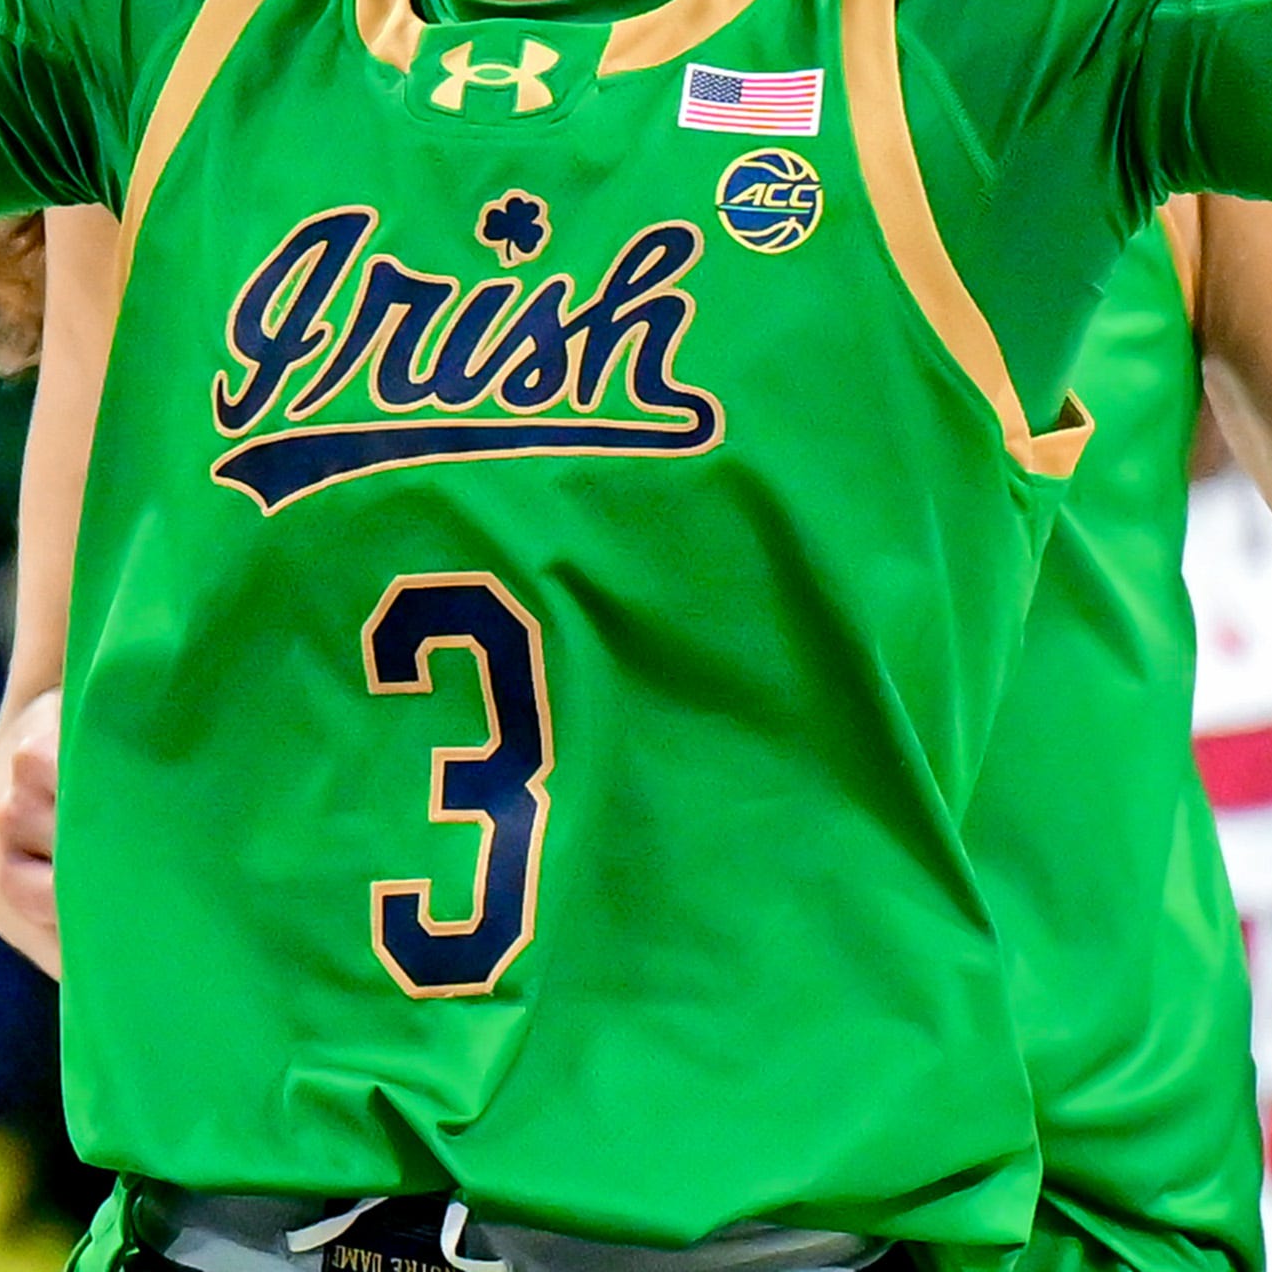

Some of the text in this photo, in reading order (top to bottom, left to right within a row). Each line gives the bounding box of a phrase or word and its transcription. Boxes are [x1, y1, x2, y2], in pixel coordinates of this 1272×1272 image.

[727, 182, 822, 208] ACC
[211, 204, 726, 515] Irish
[361, 572, 554, 998] 3
